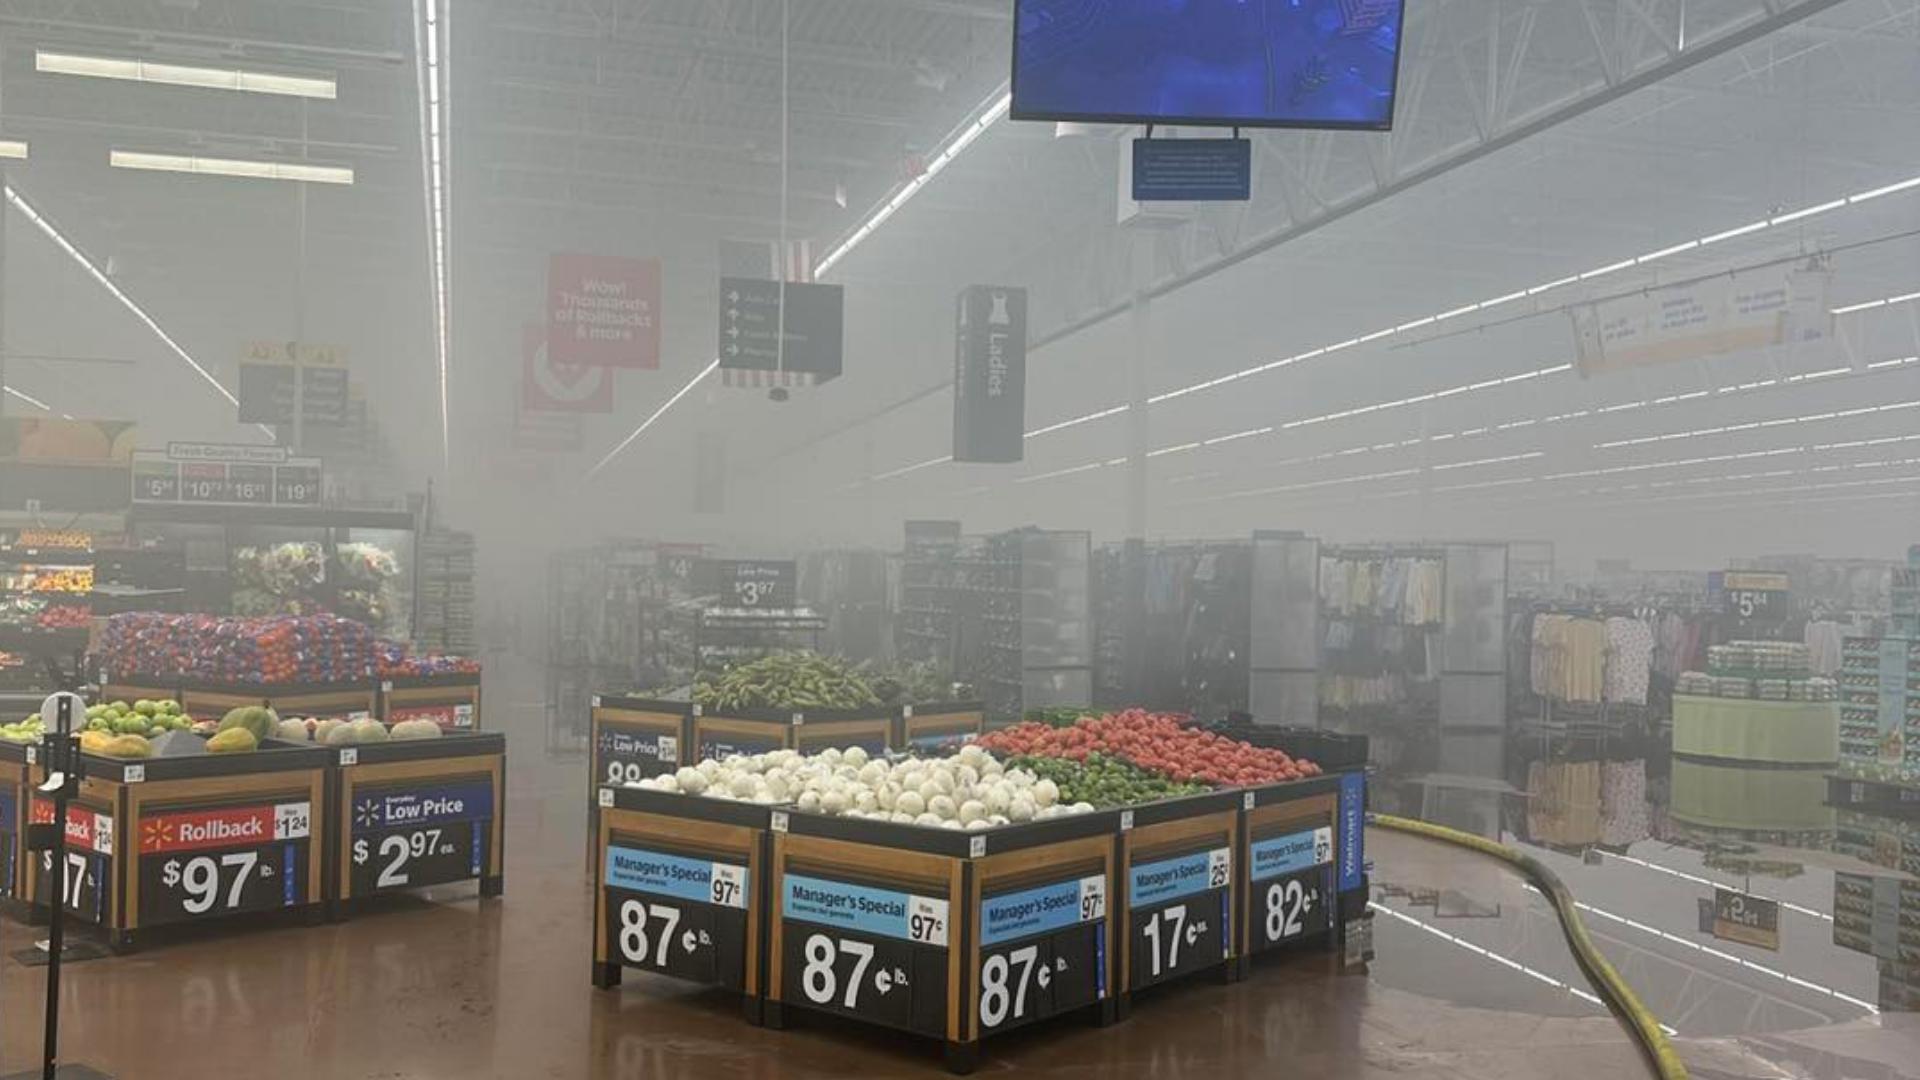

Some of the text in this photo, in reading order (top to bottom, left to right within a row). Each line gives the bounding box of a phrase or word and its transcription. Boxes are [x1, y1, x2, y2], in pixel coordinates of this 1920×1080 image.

[580, 277, 627, 295] Wow!
[559, 291, 649, 311] Thousands
[556, 309, 651, 328] of Rollbacks
[591, 328, 632, 342] more
[990, 333, 1008, 397] Ladies
[614, 738, 633, 752] Low
[634, 740, 658, 756] Price
[386, 797, 465, 821] Low Price
[180, 815, 263, 842] Rollback
[276, 815, 308, 838] $124
[1346, 811, 1359, 877] Walmart
[615, 856, 670, 880] Manager's
[671, 865, 711, 885] Special
[1136, 857, 1207, 889] Manager's Special
[792, 885, 905, 918] Manager's Special
[989, 889, 1078, 924] Manager's Special
[894, 968, 910, 986] lb.
